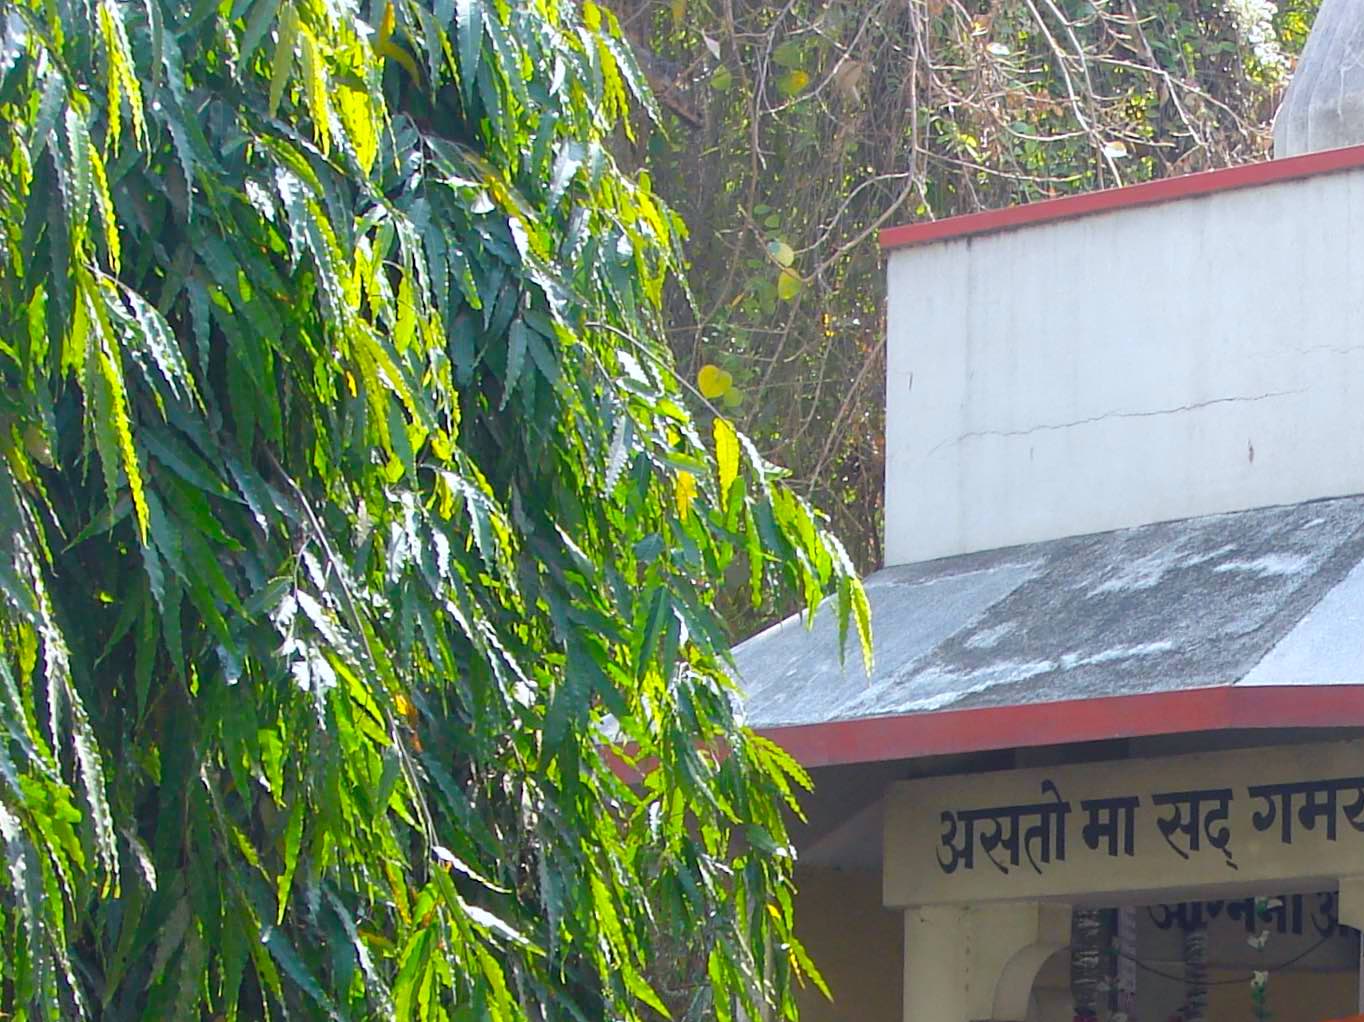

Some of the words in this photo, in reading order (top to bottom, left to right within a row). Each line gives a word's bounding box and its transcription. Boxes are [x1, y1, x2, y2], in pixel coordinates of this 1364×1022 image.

[936, 778, 1072, 875] असतो
[1081, 795, 1140, 857] मा
[1150, 787, 1239, 870] सद्
